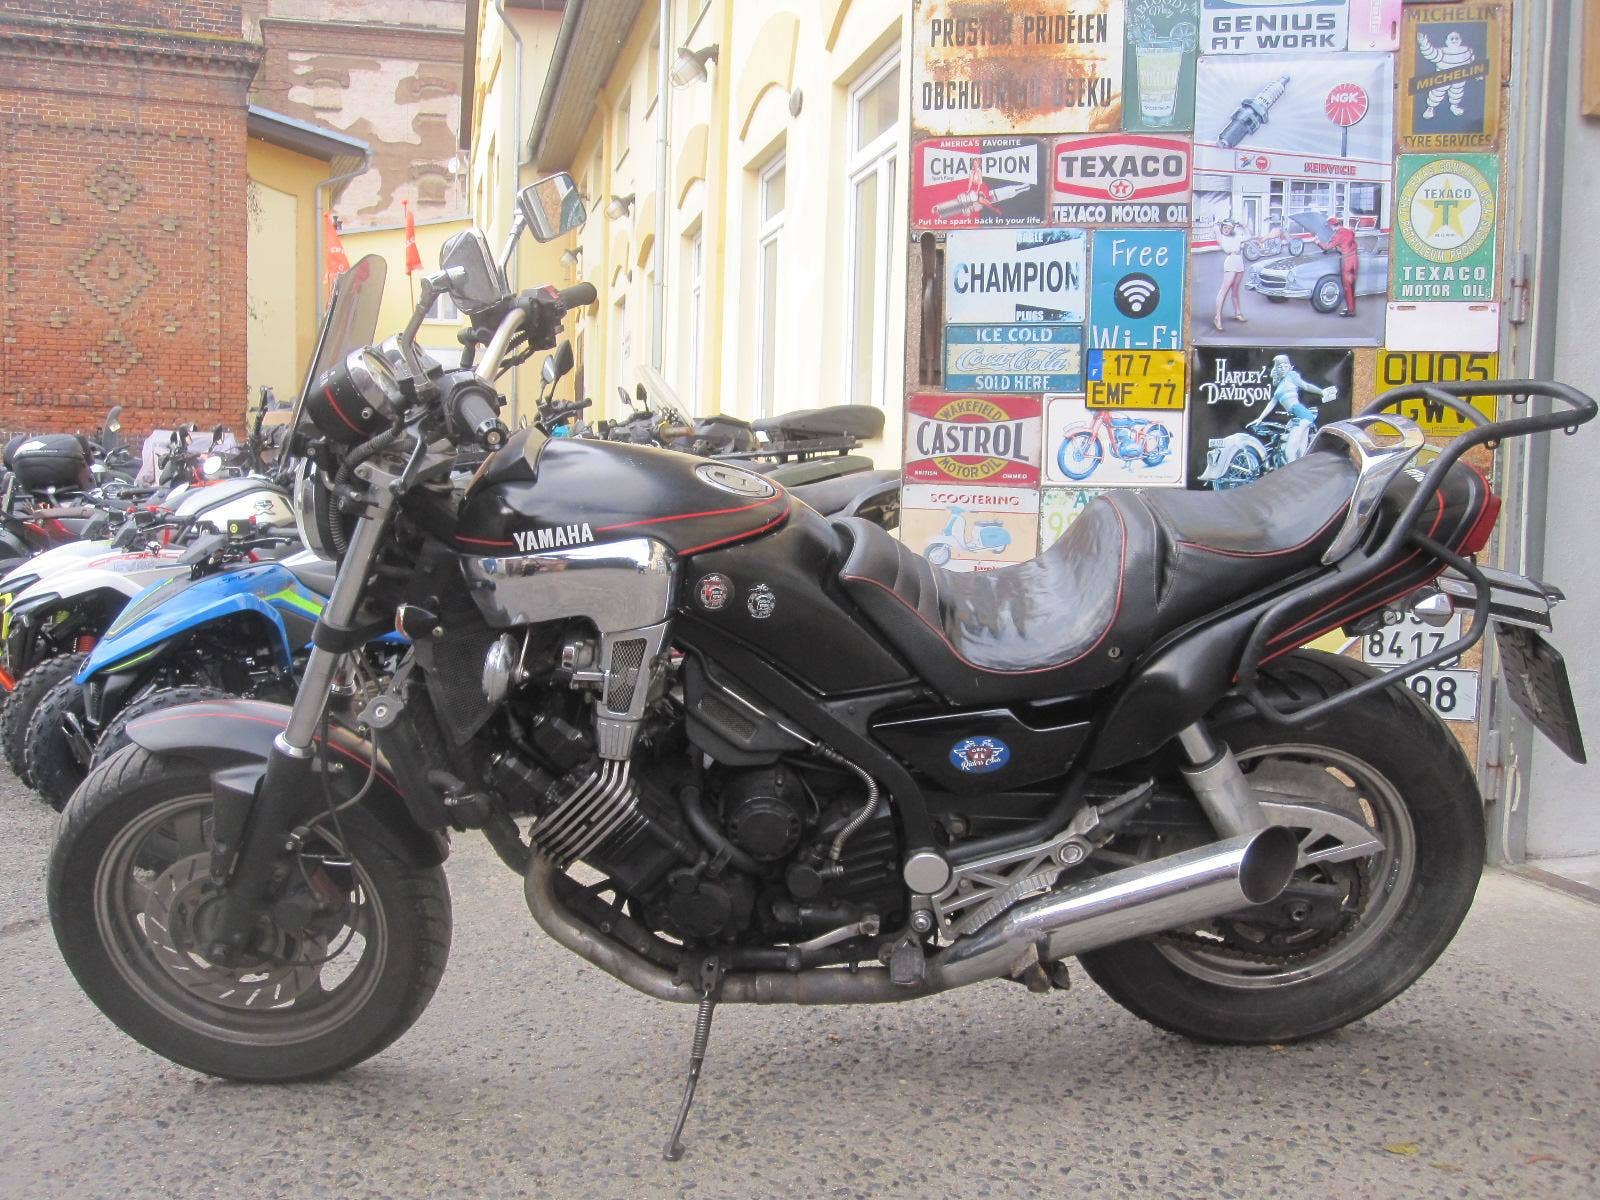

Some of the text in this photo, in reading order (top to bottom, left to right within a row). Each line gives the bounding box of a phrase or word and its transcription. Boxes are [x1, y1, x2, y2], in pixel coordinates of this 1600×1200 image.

[1212, 13, 1337, 33] GENIUS
[1407, 5, 1498, 22] MICHELIN
[1211, 34, 1336, 50] AT WORK
[1416, 64, 1485, 90] MICHELIN
[1330, 92, 1359, 104] NGK
[940, 139, 1021, 148] AMERICA'S FAVORITE
[1403, 134, 1492, 149] TYRE SERVICES
[1061, 155, 1183, 178] TEXACO
[1304, 162, 1357, 176] SERVICE
[1424, 189, 1472, 199] TEXACO
[949, 218, 972, 226] spark
[1053, 206, 1107, 223] TEXACO
[1111, 205, 1160, 223] MOTOR
[1166, 205, 1188, 223] OIL
[1434, 201, 1458, 225] T
[1112, 239, 1169, 267] Free
[954, 261, 1080, 294] CHAMPION
[1402, 267, 1486, 281] TEXACO
[1401, 284, 1485, 297] MOTOR OIL
[976, 328, 1053, 342] ICE COLD
[1093, 325, 1177, 349] Wi-Fi
[1114, 354, 1151, 377] 177
[975, 375, 1050, 391] SOLD HERE
[1092, 383, 1176, 405] EMF 77
[1199, 382, 1271, 407] DAVIDSON
[939, 400, 1003, 421] WAKEFIELD
[916, 421, 1030, 462] CASTROL
[939, 458, 1002, 478] MOTOR OIL
[930, 493, 1020, 506] SCOOTERING
[513, 522, 594, 552] YAMAHA
[1411, 675, 1457, 712] 98
